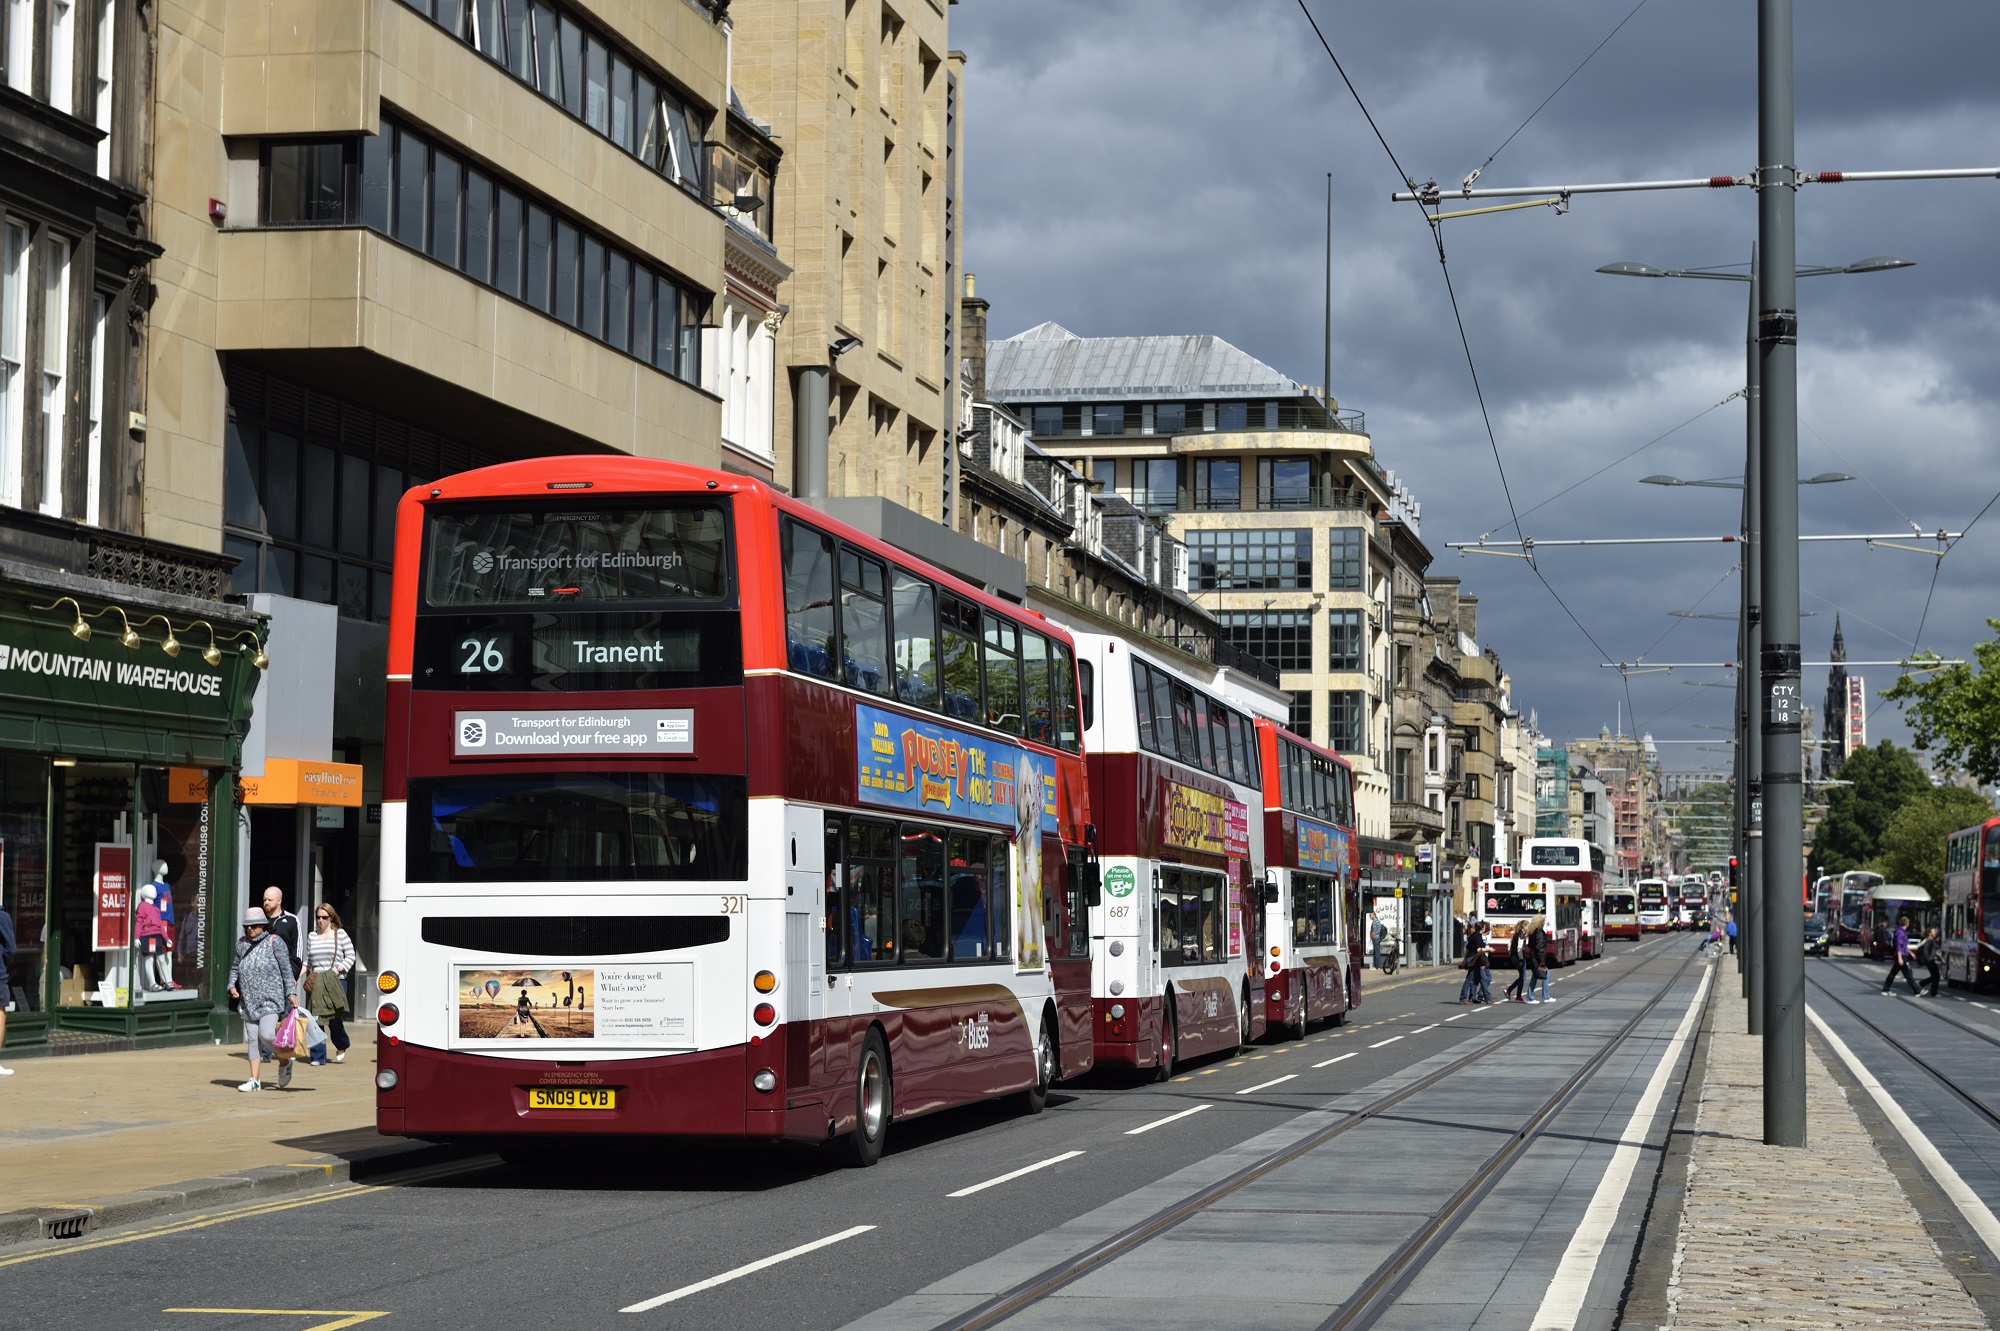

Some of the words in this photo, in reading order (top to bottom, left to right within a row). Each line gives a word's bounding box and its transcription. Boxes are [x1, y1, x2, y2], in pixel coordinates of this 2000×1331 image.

[496, 554, 573, 572] Transport
[575, 552, 599, 569] for
[601, 551, 682, 570] Edinburgh
[460, 637, 504, 673] 26
[573, 640, 664, 663] Tranent
[10, 647, 112, 682] MOUNTAIN
[117, 662, 223, 697] WAREHOUSE
[1772, 685, 1795, 696] CTY
[1778, 699, 1788, 709] 12
[512, 717, 560, 729] Transport
[561, 716, 577, 728] for
[578, 716, 631, 729] Edinburgh
[1778, 712, 1788, 722] 18
[495, 731, 560, 745] Download
[562, 734, 592, 747] your
[594, 731, 620, 744] free
[623, 733, 648, 747] app
[901, 728, 969, 800] PUDSEY
[969, 747, 986, 777] THE
[304, 771, 357, 786] easyHotel.com
[924, 783, 936, 796] THE
[937, 786, 948, 798] DOG
[969, 777, 993, 806] MOVIE
[994, 780, 1007, 806] JULY
[102, 893, 126, 909] SALE
[720, 896, 744, 914] 321
[1110, 906, 1130, 918] 687
[601, 971, 623, 980] You're
[624, 971, 645, 982] doing
[647, 971, 663, 980] well.
[601, 983, 626, 991] What's
[627, 983, 647, 991] next?
[968, 1017, 989, 1050] Buses
[536, 1090, 575, 1105] SN09
[579, 1090, 609, 1106] CVB
